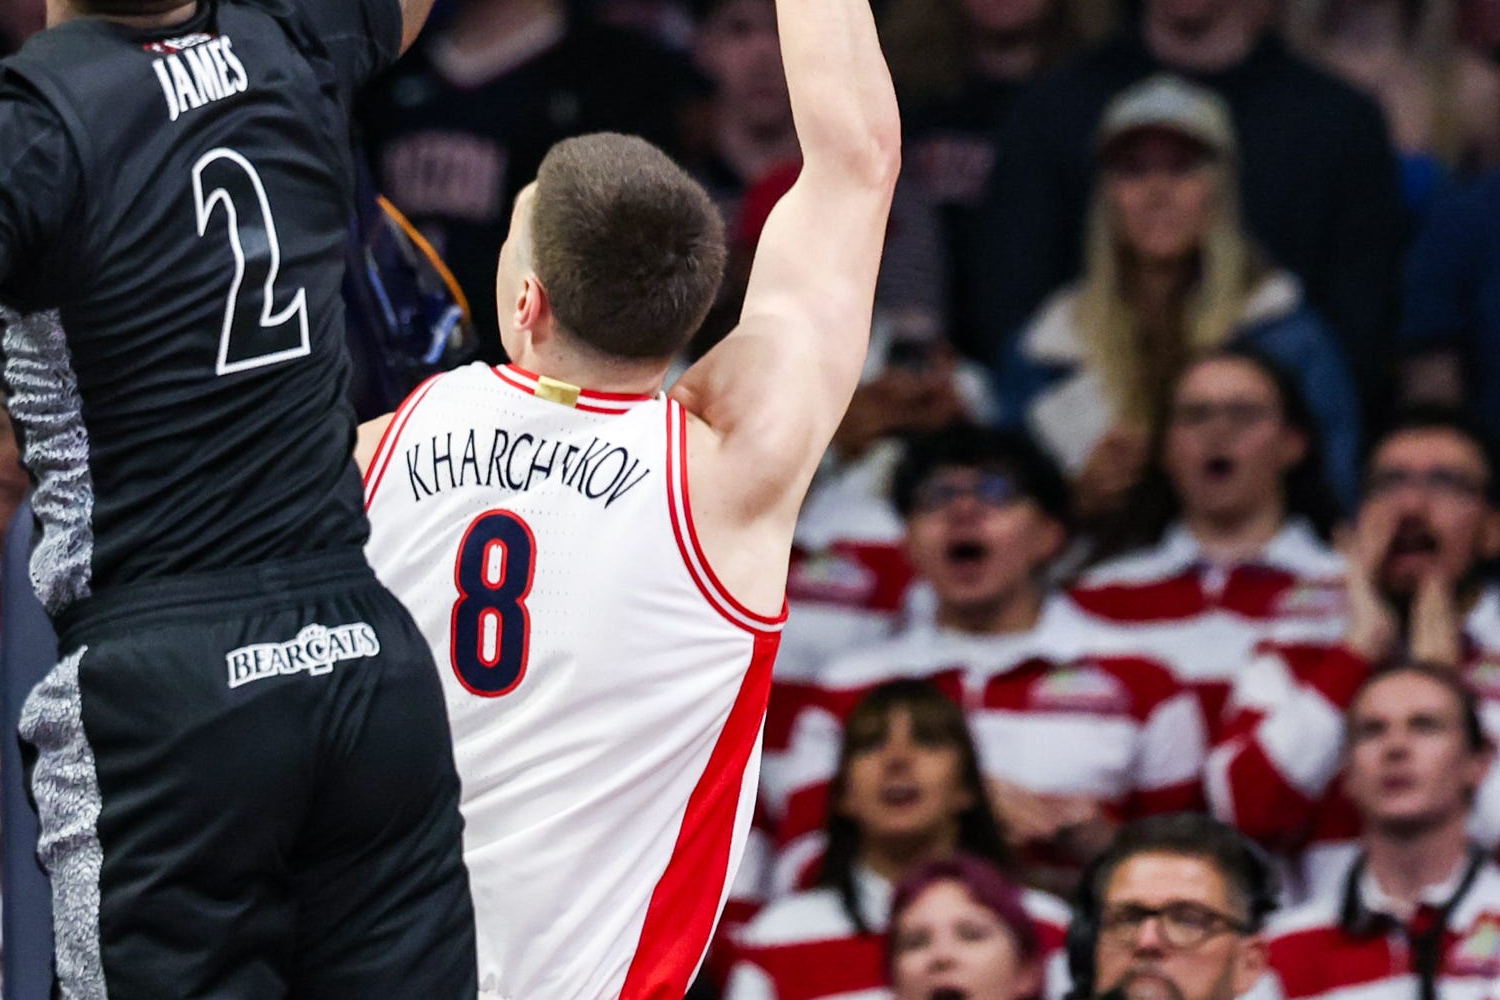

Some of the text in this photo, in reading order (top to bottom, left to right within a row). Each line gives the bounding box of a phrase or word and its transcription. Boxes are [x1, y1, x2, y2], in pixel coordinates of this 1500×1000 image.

[152, 35, 249, 122] JAMES
[192, 148, 311, 375] 2
[406, 428, 650, 509] KHARCHKOV
[450, 508, 537, 698] 8
[225, 622, 381, 689] BEARCATS
